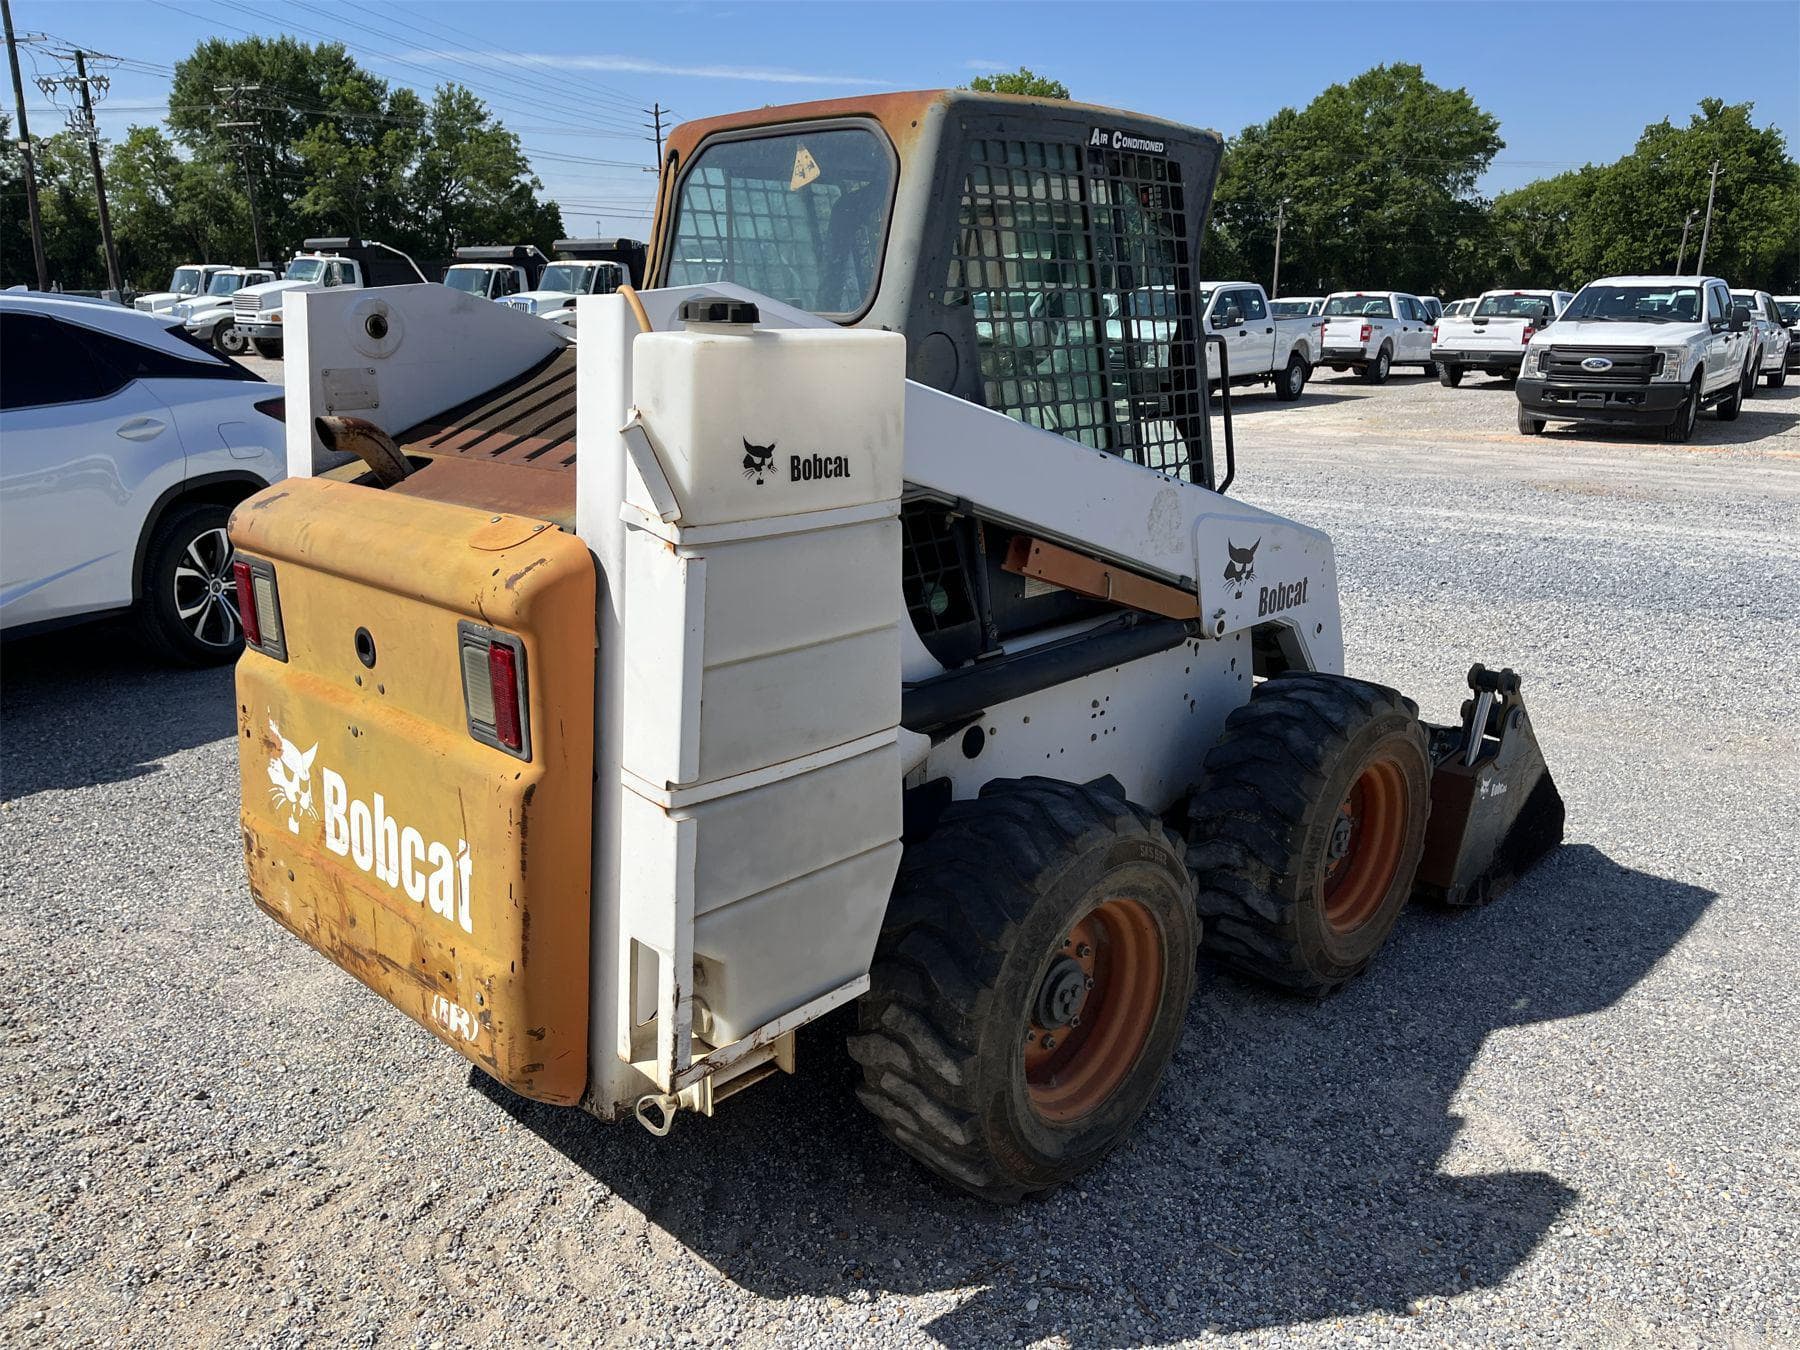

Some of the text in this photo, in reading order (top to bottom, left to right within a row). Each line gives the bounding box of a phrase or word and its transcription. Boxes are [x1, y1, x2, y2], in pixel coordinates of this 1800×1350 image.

[1090, 127, 1164, 153] AIR CONDITIONED
[790, 453, 851, 482] Bobcat
[1258, 576, 1308, 618] Bobcat
[322, 766, 473, 934] Bobcat
